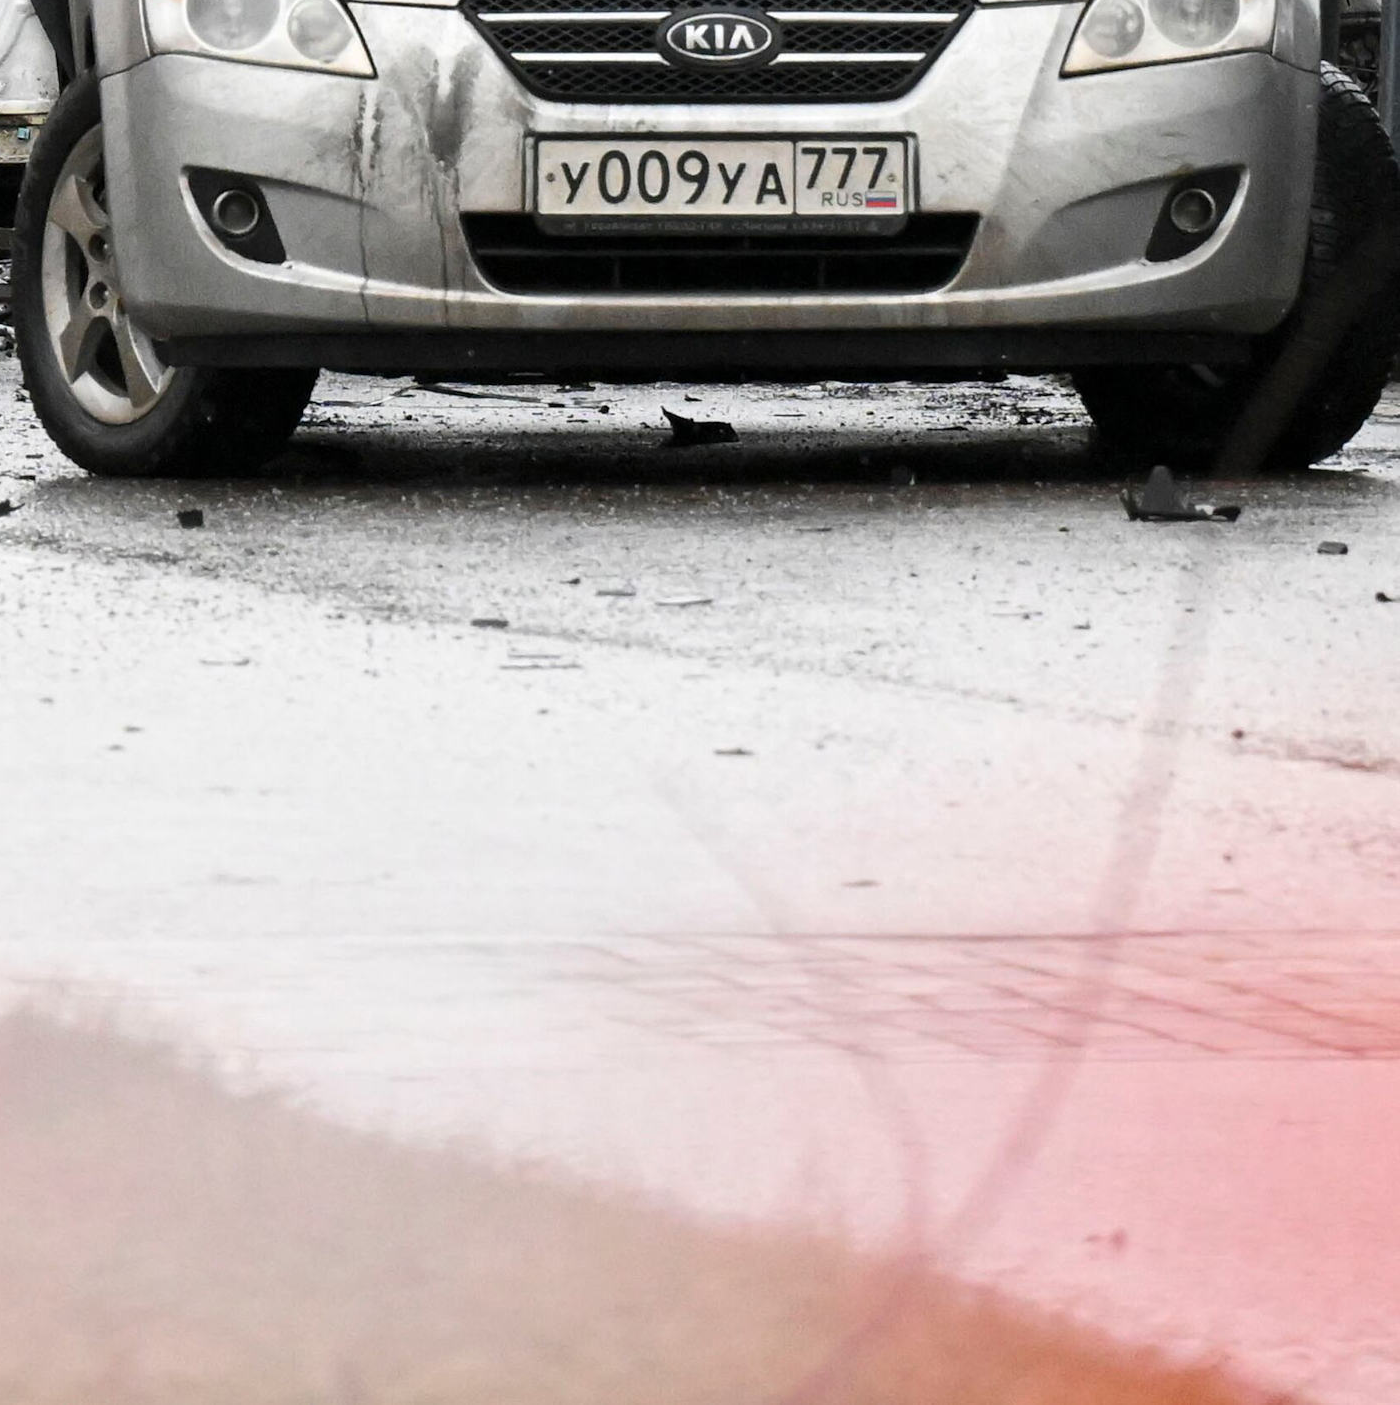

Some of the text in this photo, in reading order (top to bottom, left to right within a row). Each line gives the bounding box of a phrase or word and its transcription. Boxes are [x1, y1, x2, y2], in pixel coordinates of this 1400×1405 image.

[685, 25, 754, 50] KIA
[560, 146, 888, 205] У009УА 777
[821, 191, 864, 207] RUS
